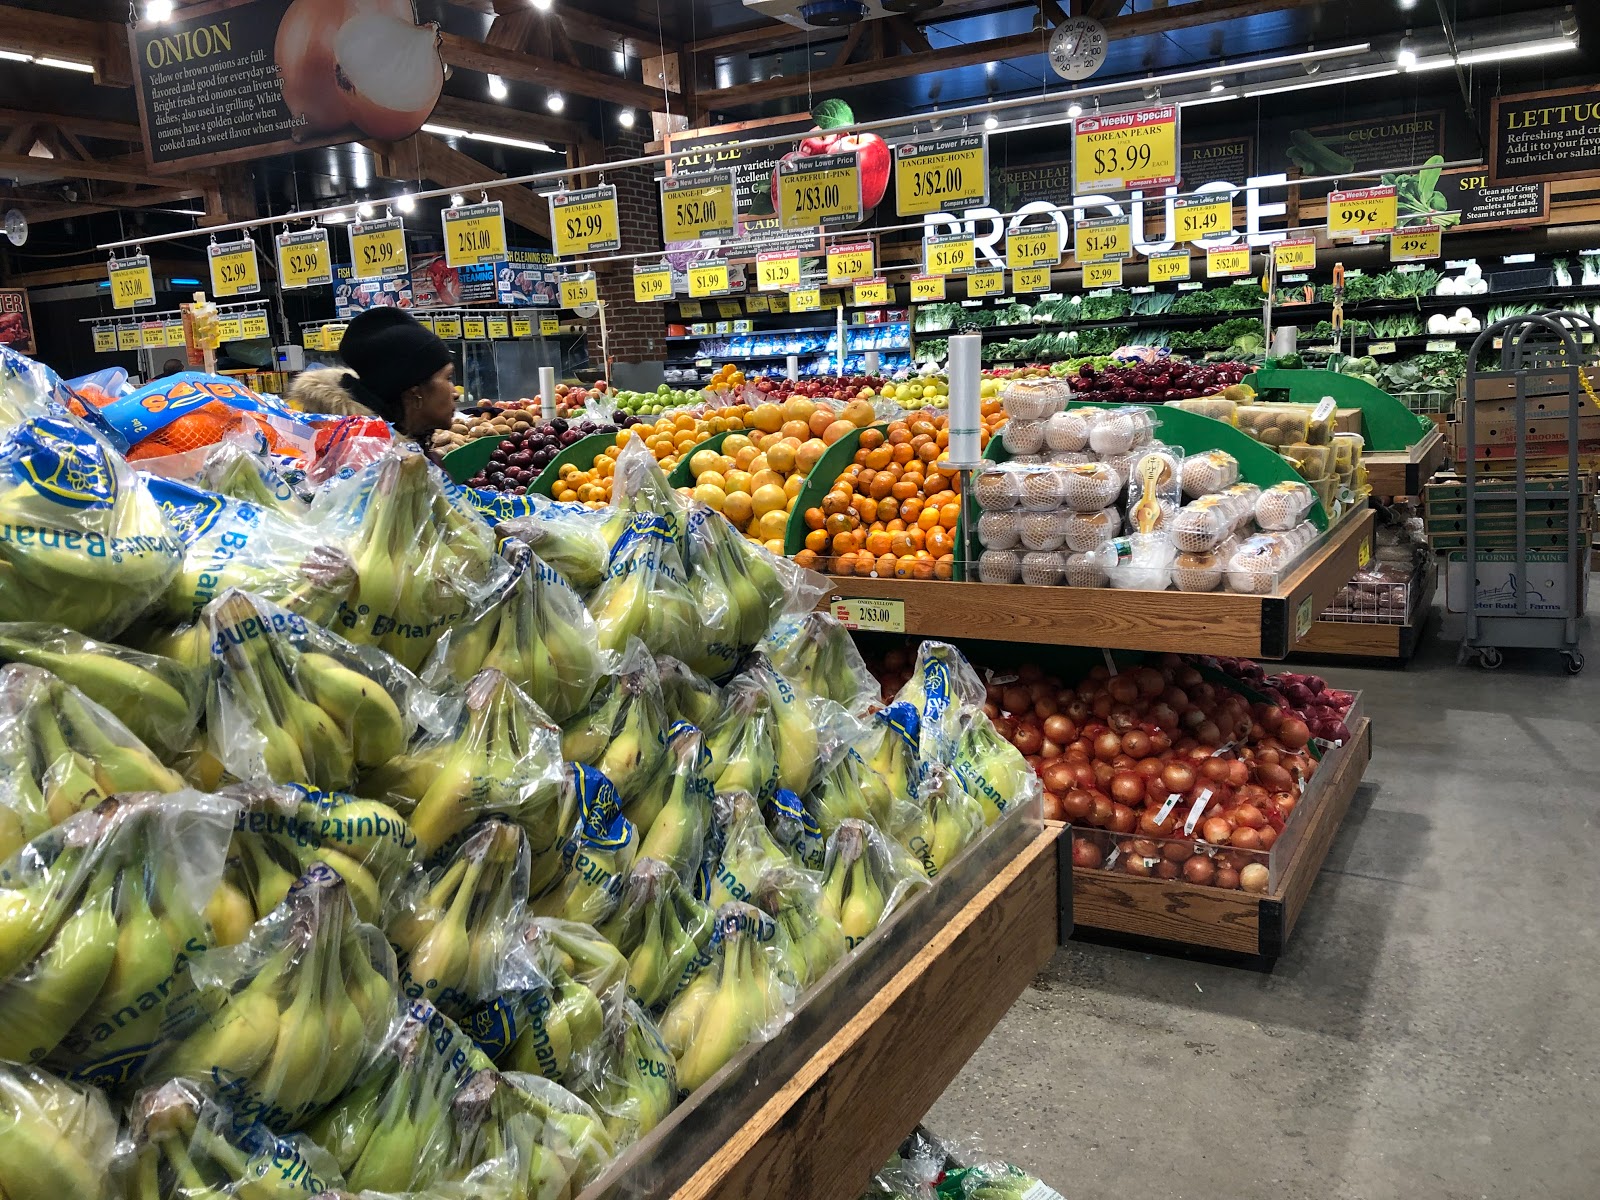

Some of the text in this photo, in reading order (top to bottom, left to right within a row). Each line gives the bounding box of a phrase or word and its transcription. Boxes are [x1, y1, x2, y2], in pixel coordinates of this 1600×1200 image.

[146, 21, 231, 69] ONION
[150, 49, 267, 86] Yellow or brown onions are full-
[1084, 60, 1094, 68] 120
[152, 64, 282, 100] flavored and good for everyday use.
[154, 77, 285, 114] Bright fresh red onions can liven up
[156, 92, 282, 126] dishes; also used in grilling. White
[158, 108, 277, 138] onions have a golden color when
[1101, 108, 1172, 126] Weekly Special
[160, 114, 309, 152] cooked and a sweet flavor when sauteed.
[1087, 126, 1162, 143] KOREAN PEARS
[1348, 120, 1434, 141] CUCUMBER
[1508, 126, 1585, 144] Refreshing and
[918, 138, 979, 152] New Lower Price
[1193, 144, 1244, 160] RADISH
[1506, 143, 1528, 154] Add
[1530, 142, 1538, 151] it
[1540, 142, 1550, 150] to
[1554, 140, 1578, 152] your
[677, 140, 742, 167] APPLE
[901, 151, 977, 168] TANGERINE-HONEY
[1094, 144, 1169, 176] $3.99 EACH
[1506, 150, 1554, 164] sandwich
[1556, 151, 1568, 159] or
[798, 156, 854, 170] New Lower Price
[694, 176, 712, 184] Lower
[714, 174, 728, 182] Price
[784, 170, 851, 184] GRAPEFRUIT-PINK
[914, 166, 962, 197] 3/$2.00
[998, 166, 1069, 184] GREEN LEAF
[1016, 176, 1070, 192] LETTUCE
[1478, 188, 1499, 196] Clean
[1516, 184, 1539, 192] Crisp!
[581, 192, 597, 200] Lower
[796, 184, 840, 212] 2/$3.00
[1370, 188, 1394, 196] Special
[1485, 195, 1505, 203] Great
[1518, 192, 1538, 200] soup,
[486, 206, 498, 214] Price
[564, 202, 603, 214] PLUM-BLACK
[944, 200, 964, 208] Compare
[1473, 198, 1538, 212] omelets and salad.
[676, 200, 716, 226] 5/$2.00
[1341, 208, 1378, 226] 99¢
[1466, 212, 1488, 220] Steam
[1506, 207, 1528, 215] braise
[566, 214, 602, 240] $2.99
[1184, 212, 1218, 232] $1.49
[458, 230, 490, 252] 2/$1.00
[1086, 234, 1117, 252] $1.49
[1400, 240, 1427, 252] 49¢
[364, 242, 393, 265] $2.99
[514, 251, 541, 263] CLEANING
[1017, 241, 1046, 258] $1.69
[290, 254, 318, 274] $2.99
[936, 250, 964, 266] $1.69
[1216, 257, 1240, 270] 5/$2.00
[220, 262, 246, 284] $2.99
[337, 268, 350, 278] FISH
[766, 266, 789, 282] $1.29
[837, 260, 862, 275] $1.29
[1090, 268, 1112, 280] $2.99
[1158, 262, 1180, 274] $1.99
[458, 271, 494, 282] STEAMING
[696, 274, 718, 288] $1.99
[1020, 274, 1042, 286] $2.49
[120, 278, 143, 297] 3/$3.00
[641, 279, 662, 294] $1.99
[918, 284, 936, 294] 99¢
[974, 279, 995, 290] $2.49
[568, 288, 588, 300] $1.59
[861, 289, 878, 299] 99¢
[1462, 554, 1562, 562] CIFORNIA OMAINE
[1530, 602, 1561, 610] Farms
[860, 607, 890, 622] 2/$3.00
